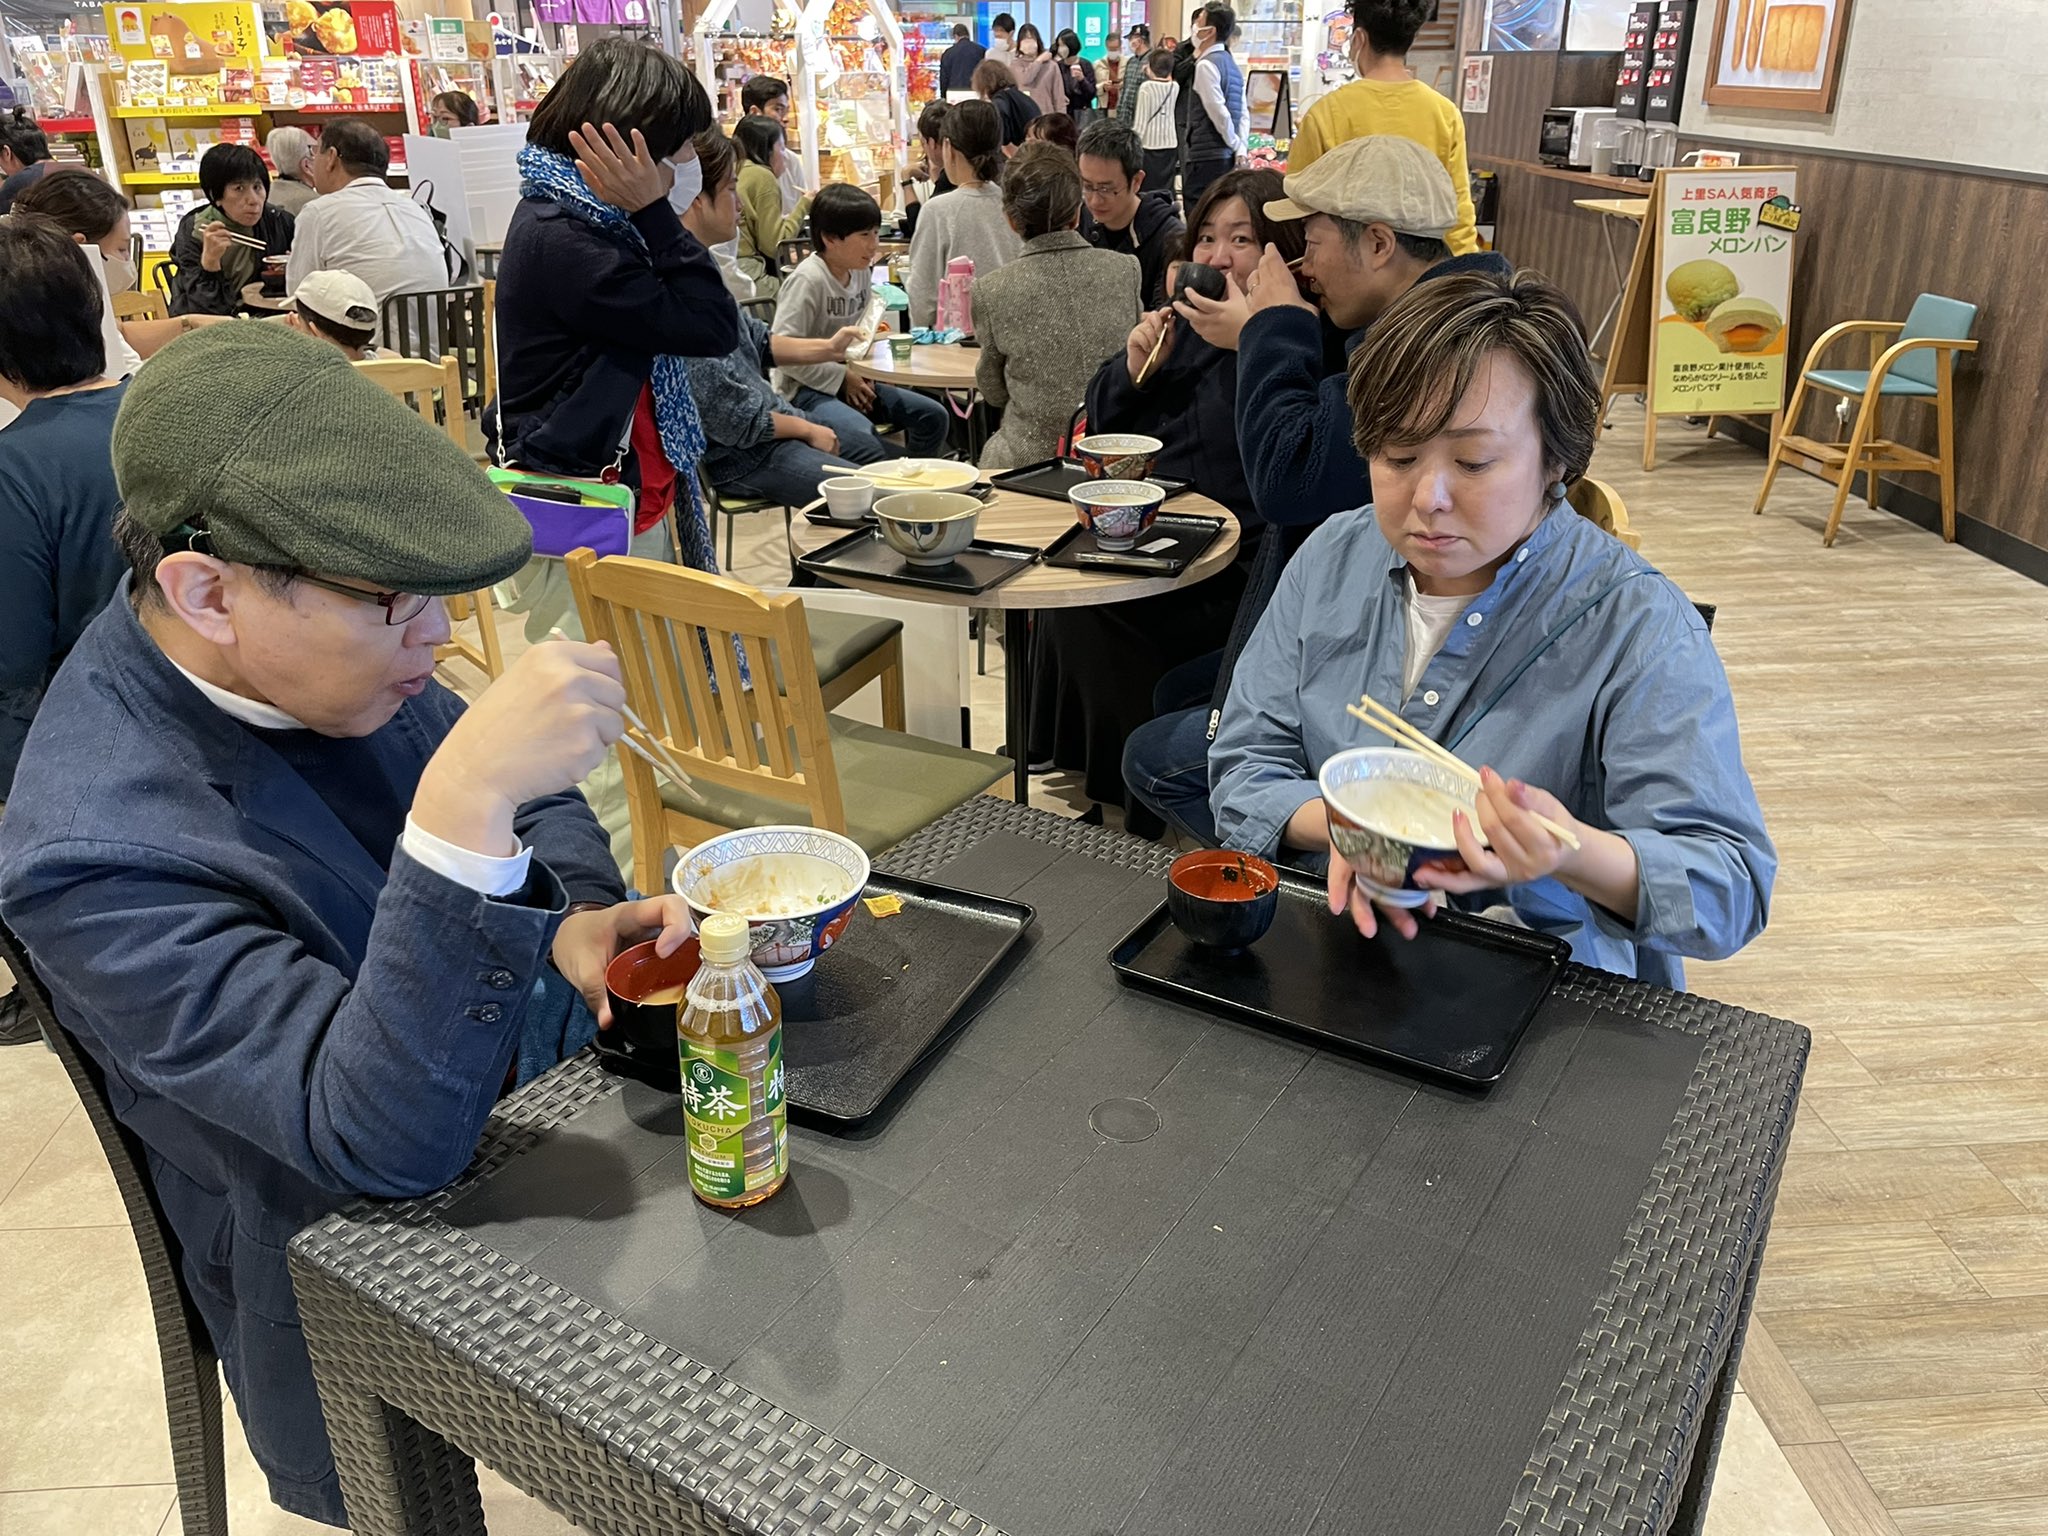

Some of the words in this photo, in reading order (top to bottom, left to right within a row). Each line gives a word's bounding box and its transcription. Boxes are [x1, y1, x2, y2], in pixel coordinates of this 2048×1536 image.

[1681, 186, 1779, 201] 上里SA人気商品
[1671, 207, 1751, 236] 富良野
[1708, 235, 1788, 254] メロンパン
[1673, 362, 1766, 373] 富良野メロン果汁使用した
[1672, 371, 1768, 382] なめらかなクリームを包んだ
[1672, 384, 1722, 393] メロンパンです
[681, 1071, 747, 1121] 特茶
[687, 1114, 733, 1134] TOKUCHA
